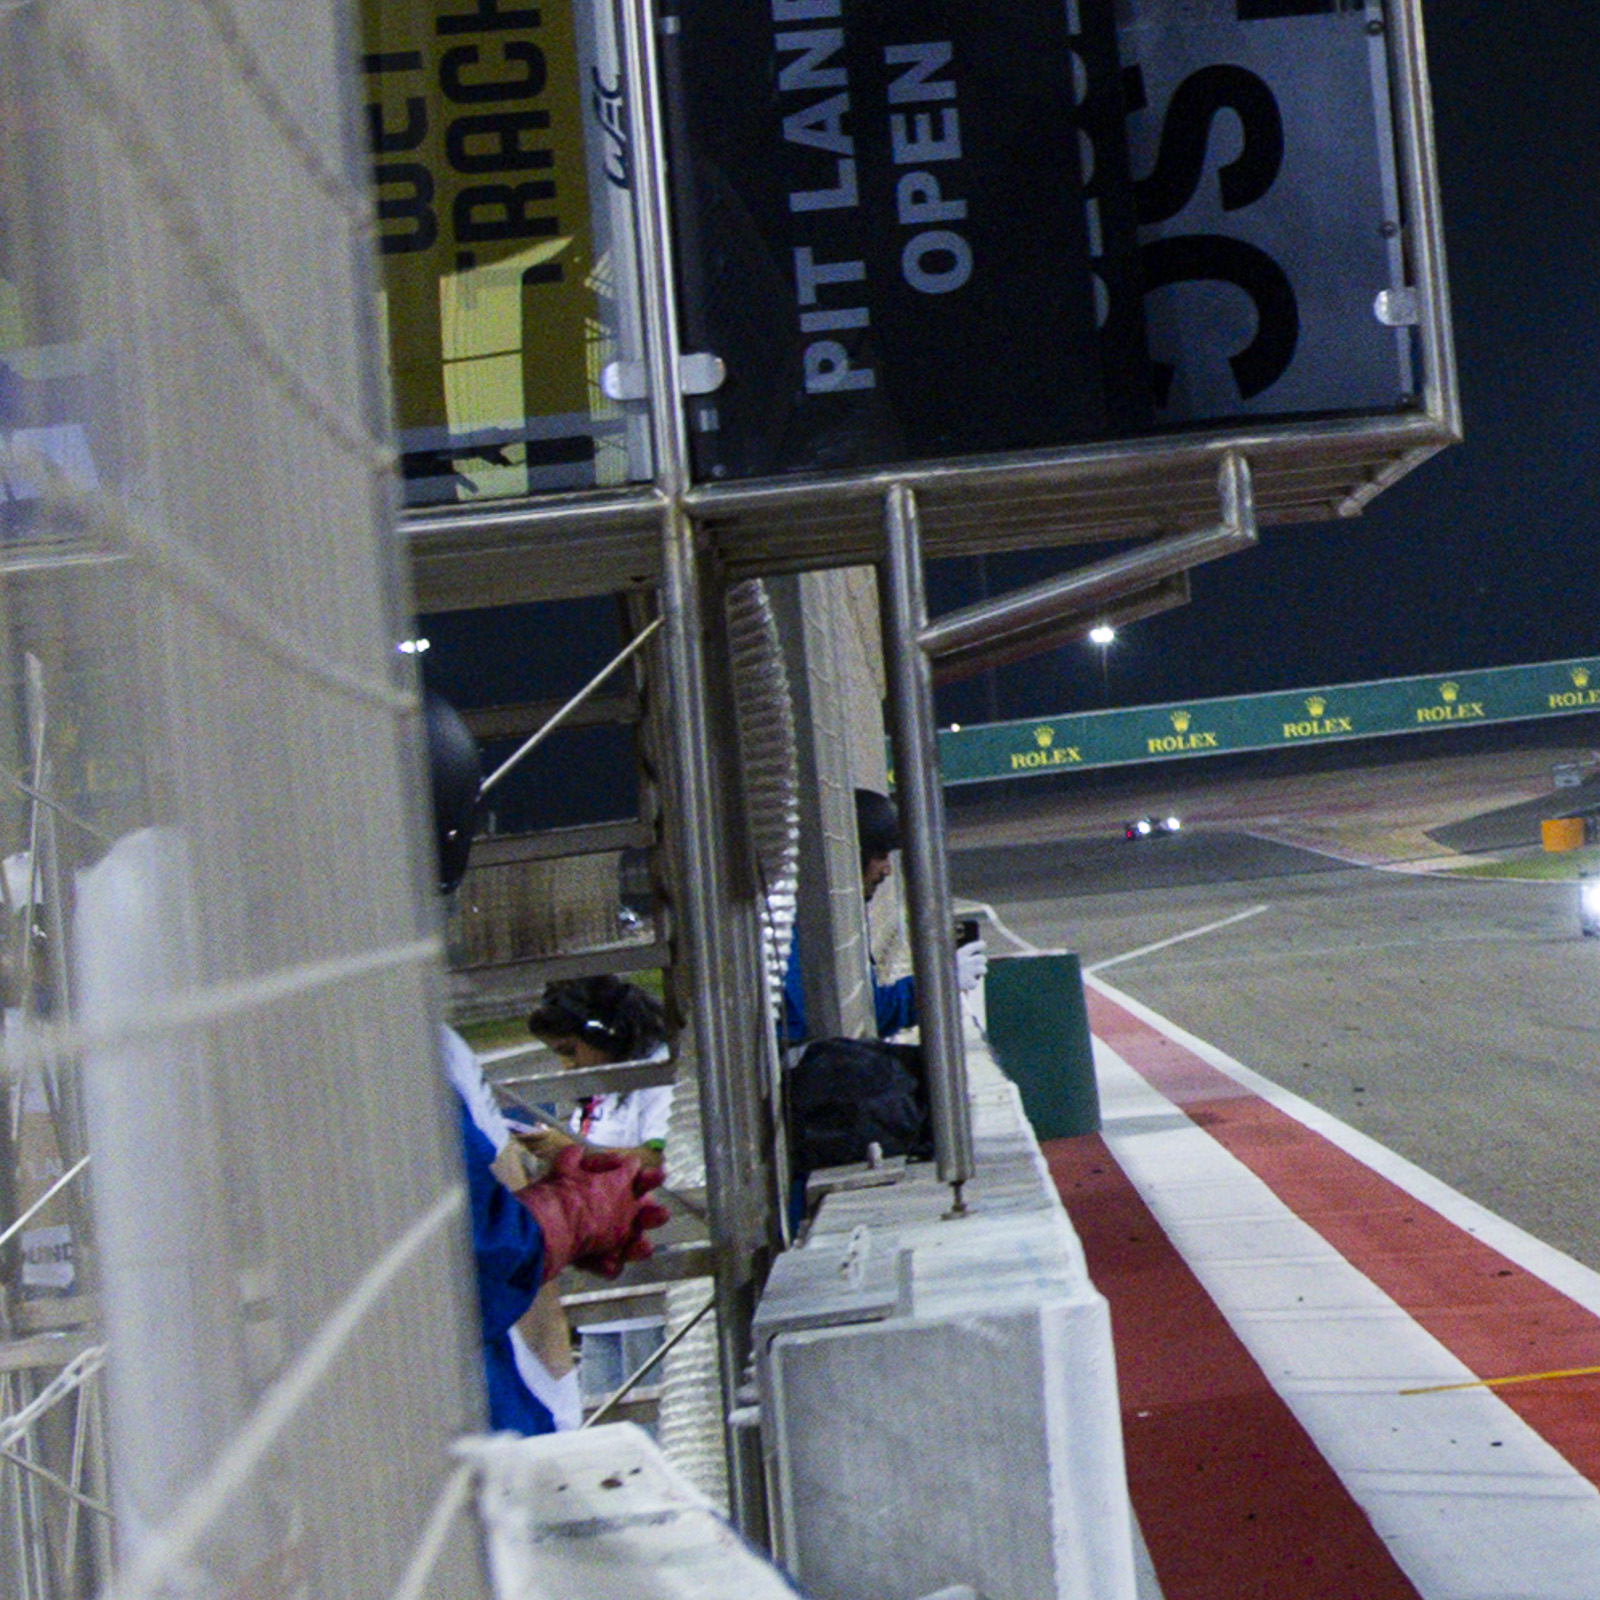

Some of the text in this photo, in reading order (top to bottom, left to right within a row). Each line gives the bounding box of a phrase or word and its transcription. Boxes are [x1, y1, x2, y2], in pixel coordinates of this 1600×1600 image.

[884, 40, 974, 295] OPEN
[793, 245, 877, 395] PIT
[1416, 702, 1485, 724] ROLEX
[1283, 716, 1353, 738] ROLEX
[1147, 731, 1218, 754] ROLEX
[1011, 746, 1083, 770] ROLEX
